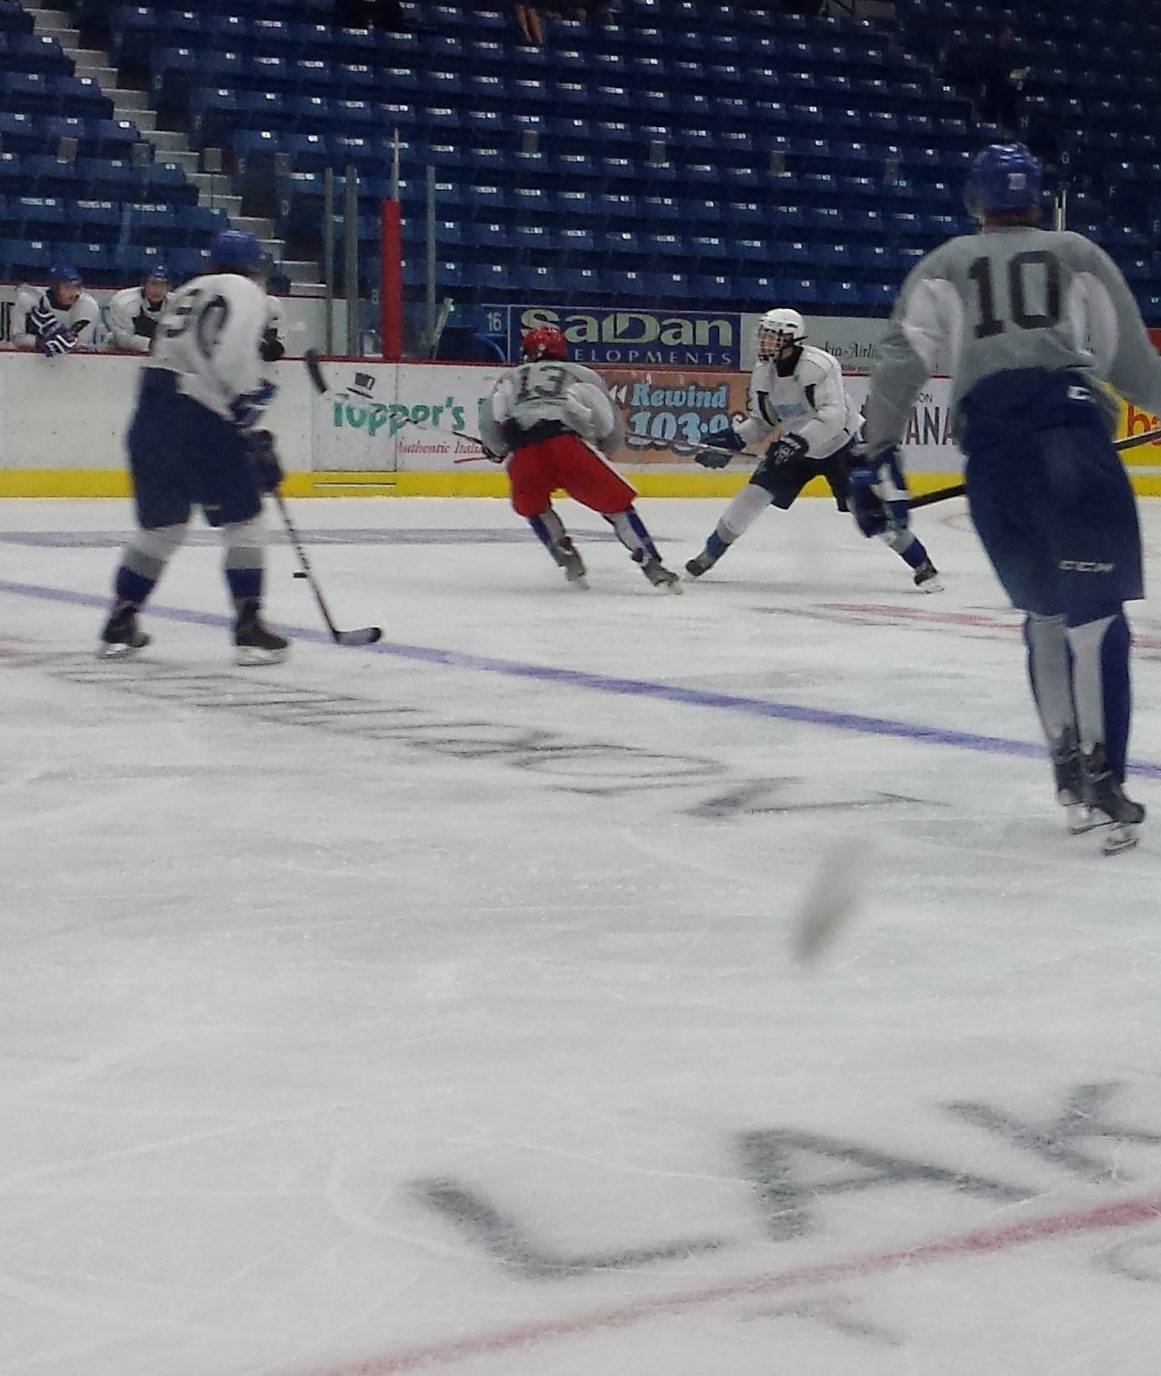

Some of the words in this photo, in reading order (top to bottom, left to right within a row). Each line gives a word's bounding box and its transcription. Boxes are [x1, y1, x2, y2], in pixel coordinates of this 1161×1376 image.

[967, 250, 1061, 339] 10
[487, 312, 502, 332] 16
[520, 308, 733, 347] SaDan
[573, 348, 732, 365] ELOPMENTS
[518, 364, 567, 402] 13
[630, 380, 728, 409] Rewind
